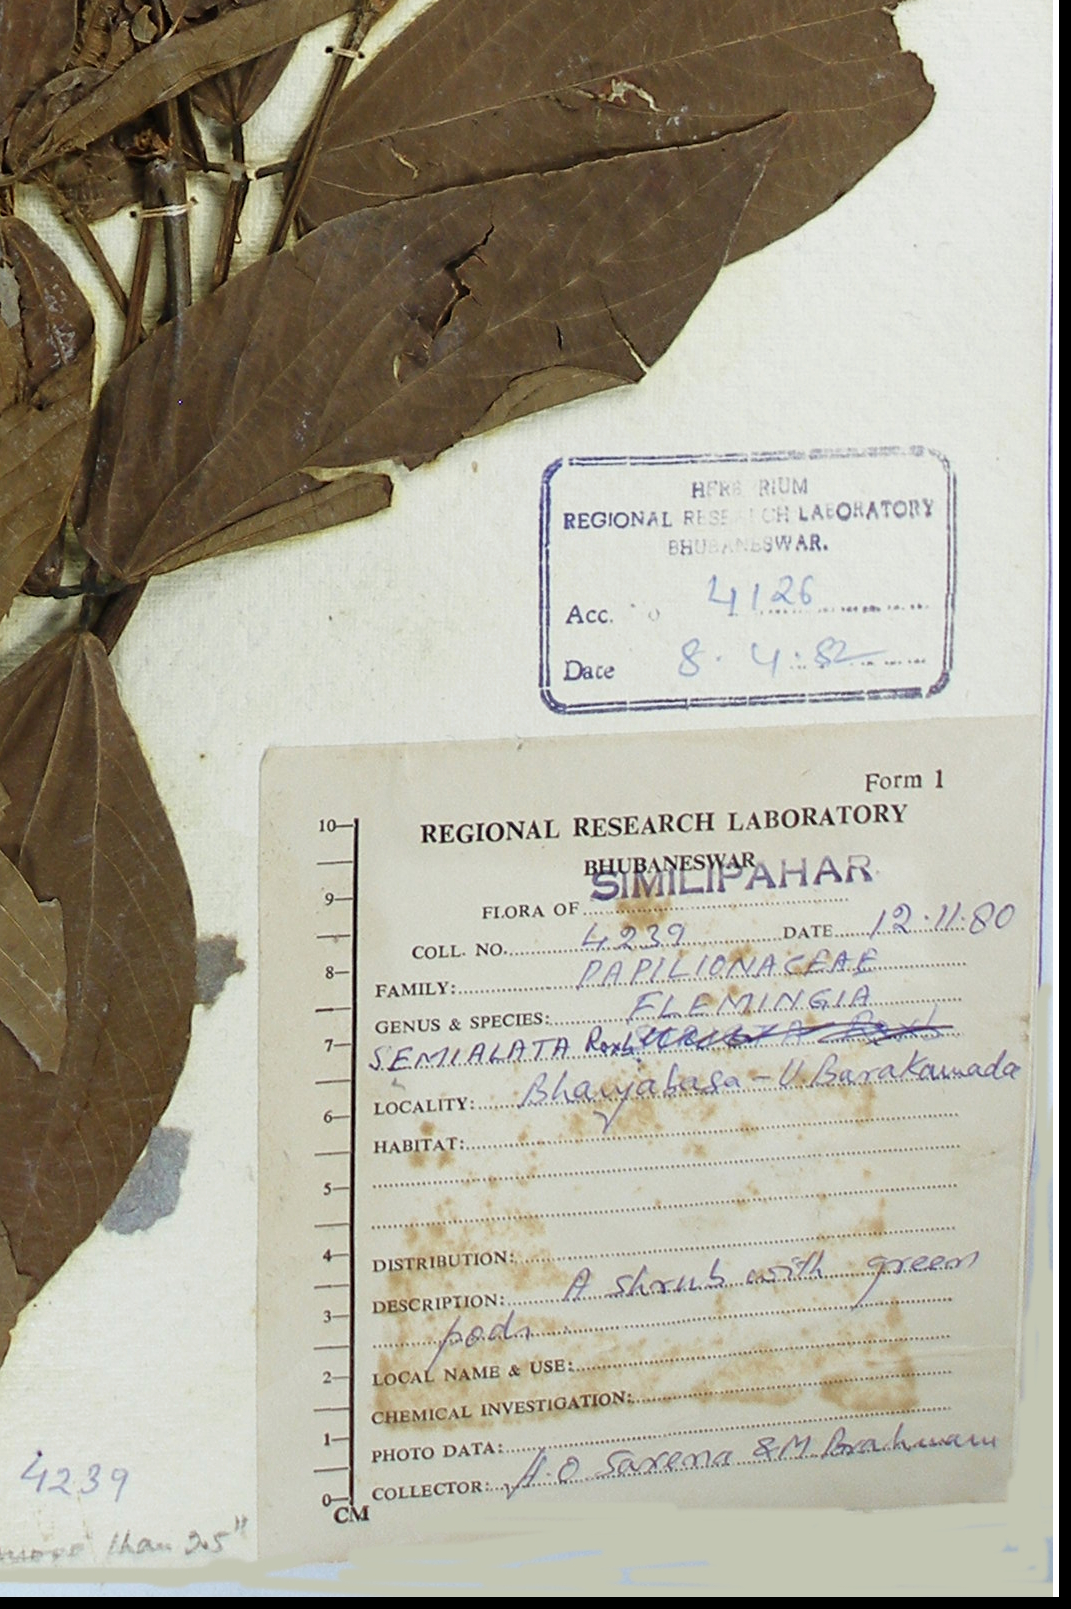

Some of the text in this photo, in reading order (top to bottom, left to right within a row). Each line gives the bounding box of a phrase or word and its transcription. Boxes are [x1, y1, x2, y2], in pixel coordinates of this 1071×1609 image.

[563, 511, 674, 531] REGIONAL
[707, 573, 817, 617] 4126
[565, 604, 614, 624] Acc.
[563, 659, 615, 682] Date
[865, 769, 943, 792] Form 1
[318, 819, 336, 832] 10
[420, 803, 908, 845] REGIONAL RESEARCH LABORATORY
[583, 851, 755, 877] BHUBANESWAR
[590, 854, 873, 902] SIMILIPAHAR
[325, 892, 334, 906] 9
[482, 901, 580, 920] FLORA OF
[582, 922, 686, 952] 4239
[783, 923, 833, 940] DATE
[411, 944, 467, 960] COLL.
[325, 966, 334, 979] 8
[577, 947, 879, 992] PAPILIONACEAE
[375, 980, 456, 999] FAMILY:
[627, 984, 871, 1026] FLEMINGIA
[375, 1012, 550, 1034] GENUS & SPECIES:
[324, 1039, 333, 1052] 7
[368, 1036, 569, 1072] SEMIALATA
[324, 1110, 333, 1123] 6
[374, 1097, 474, 1116] LOCALITY:
[374, 1136, 464, 1154] HABITAT:
[323, 1183, 332, 1196] 5
[323, 1249, 332, 1262] 4
[372, 1250, 515, 1273] DISTRIBUTION:
[563, 1249, 980, 1312] A shrub with green
[372, 1294, 505, 1315] DESCRIPTION:
[323, 1310, 331, 1323] 3
[323, 1371, 331, 1384] 2
[372, 1359, 573, 1387] LOCAL NAME & USE:
[371, 1390, 632, 1425] CHEMICAL INVESTIGATION:
[324, 1433, 331, 1446] 1
[371, 1442, 504, 1464] PHOTO DATA:
[20, 1450, 130, 1498] 4239
[322, 1494, 331, 1507] 0
[371, 1481, 490, 1502] COLLECTOR:
[333, 1505, 370, 1524] CM
